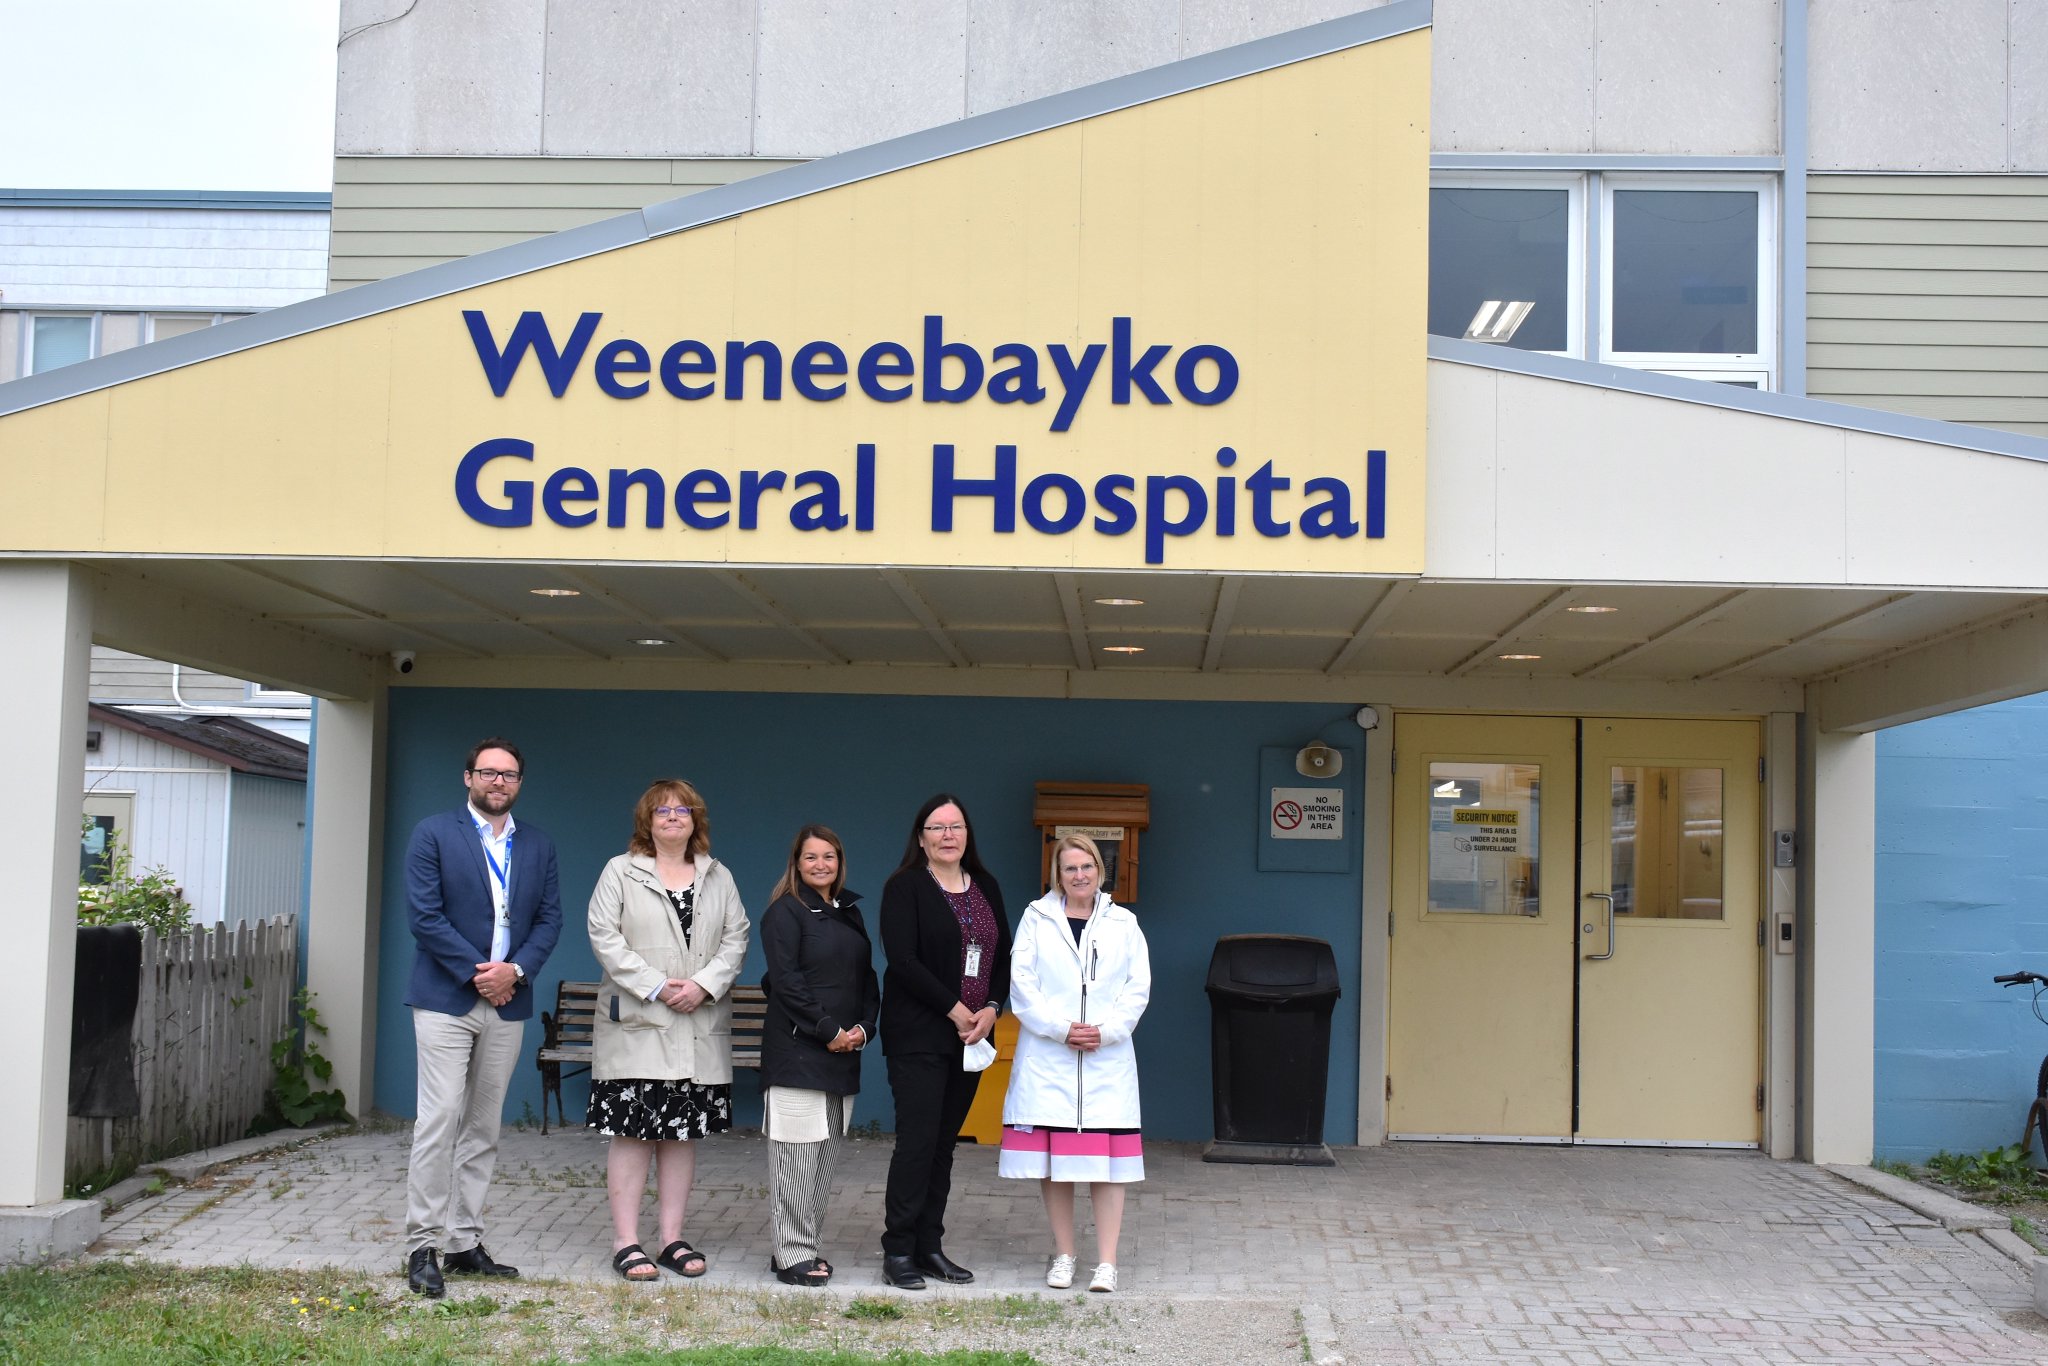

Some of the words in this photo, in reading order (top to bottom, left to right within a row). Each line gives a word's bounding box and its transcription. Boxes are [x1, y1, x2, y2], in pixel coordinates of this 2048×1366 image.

[463, 310, 1239, 431] Weeneebayko
[454, 438, 876, 532] General
[931, 445, 1386, 564] Hospital
[1303, 805, 1341, 813] SMOKING
[1456, 812, 1489, 822] SECURITY
[1491, 813, 1517, 824] NOTICE
[1310, 822, 1333, 830] AREA
[1494, 827, 1510, 835] AREA
[1500, 836, 1517, 844] HOUR
[1473, 845, 1517, 853] SURVEILLANCE
